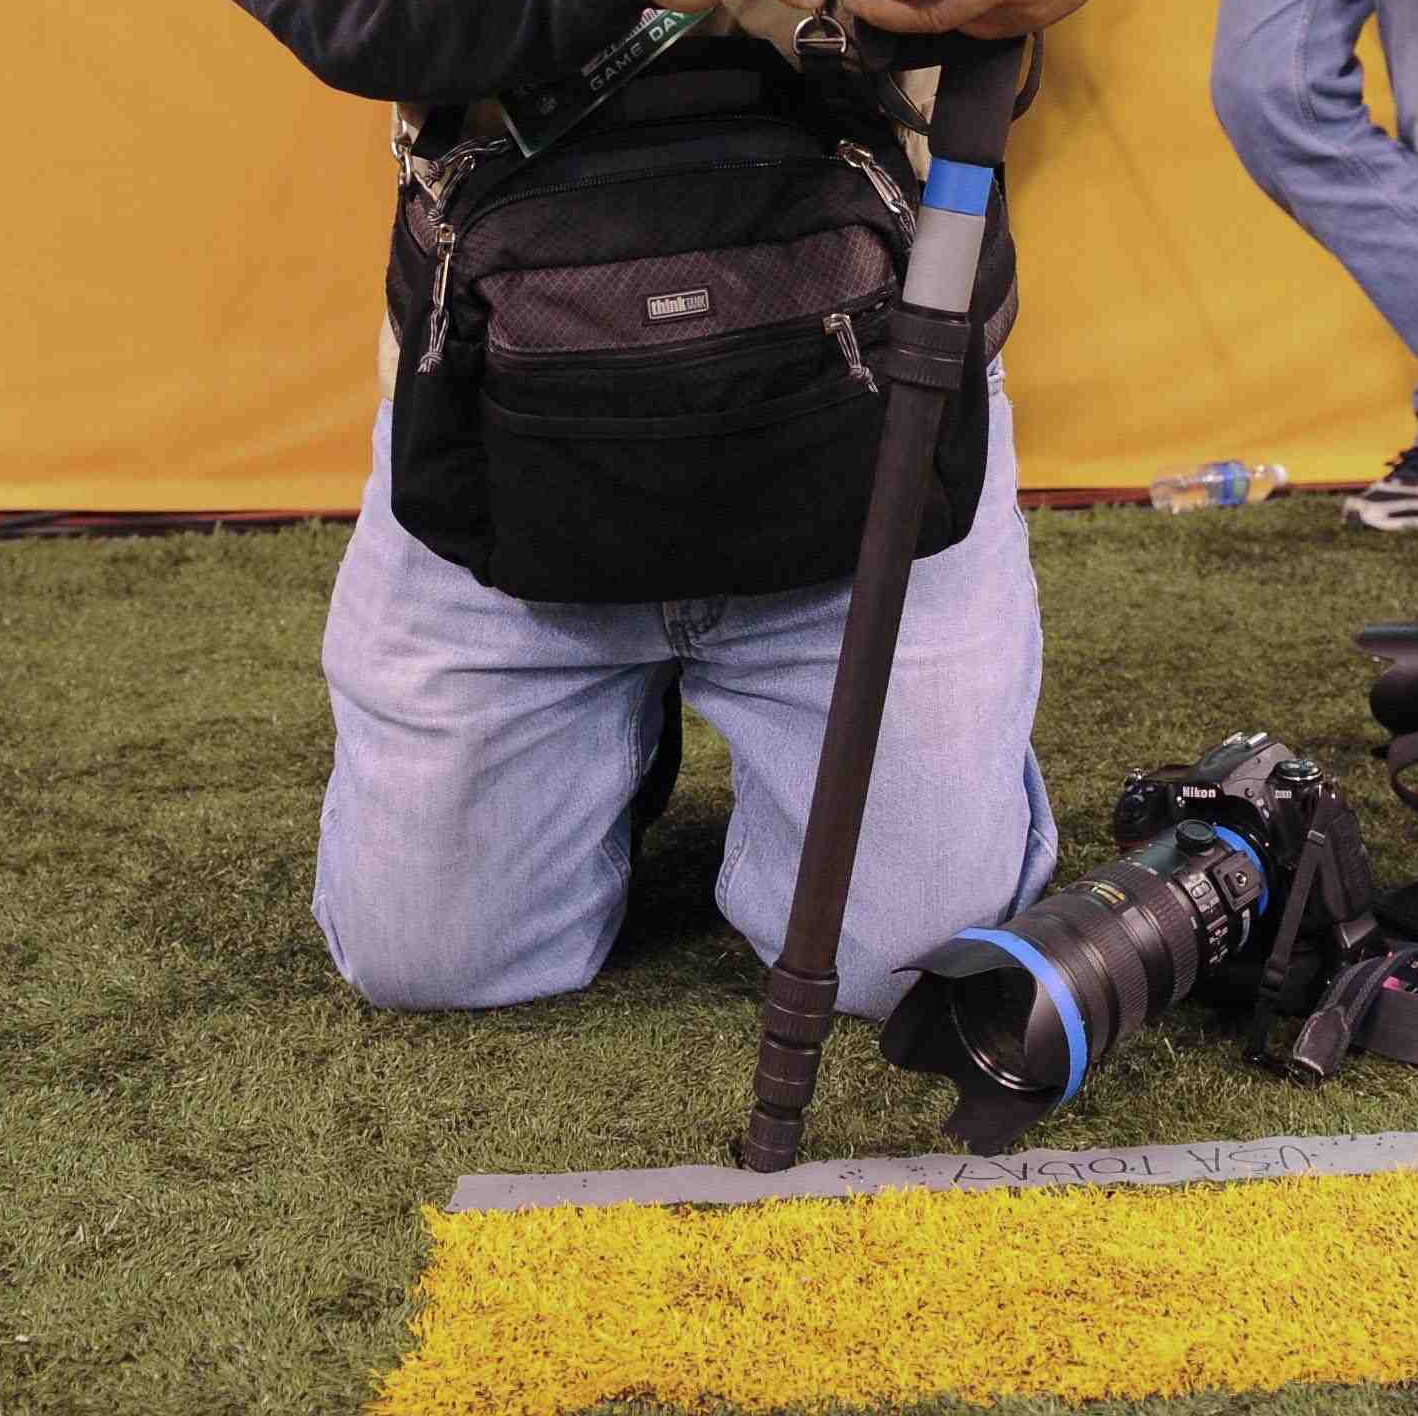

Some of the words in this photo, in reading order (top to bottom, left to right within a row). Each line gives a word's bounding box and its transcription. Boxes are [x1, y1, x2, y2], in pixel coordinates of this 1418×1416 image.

[589, 42, 646, 92] GAME
[1182, 786, 1217, 799] Nikon
[953, 1154, 1173, 1183] TODAY
[1186, 1144, 1311, 1174] USA
